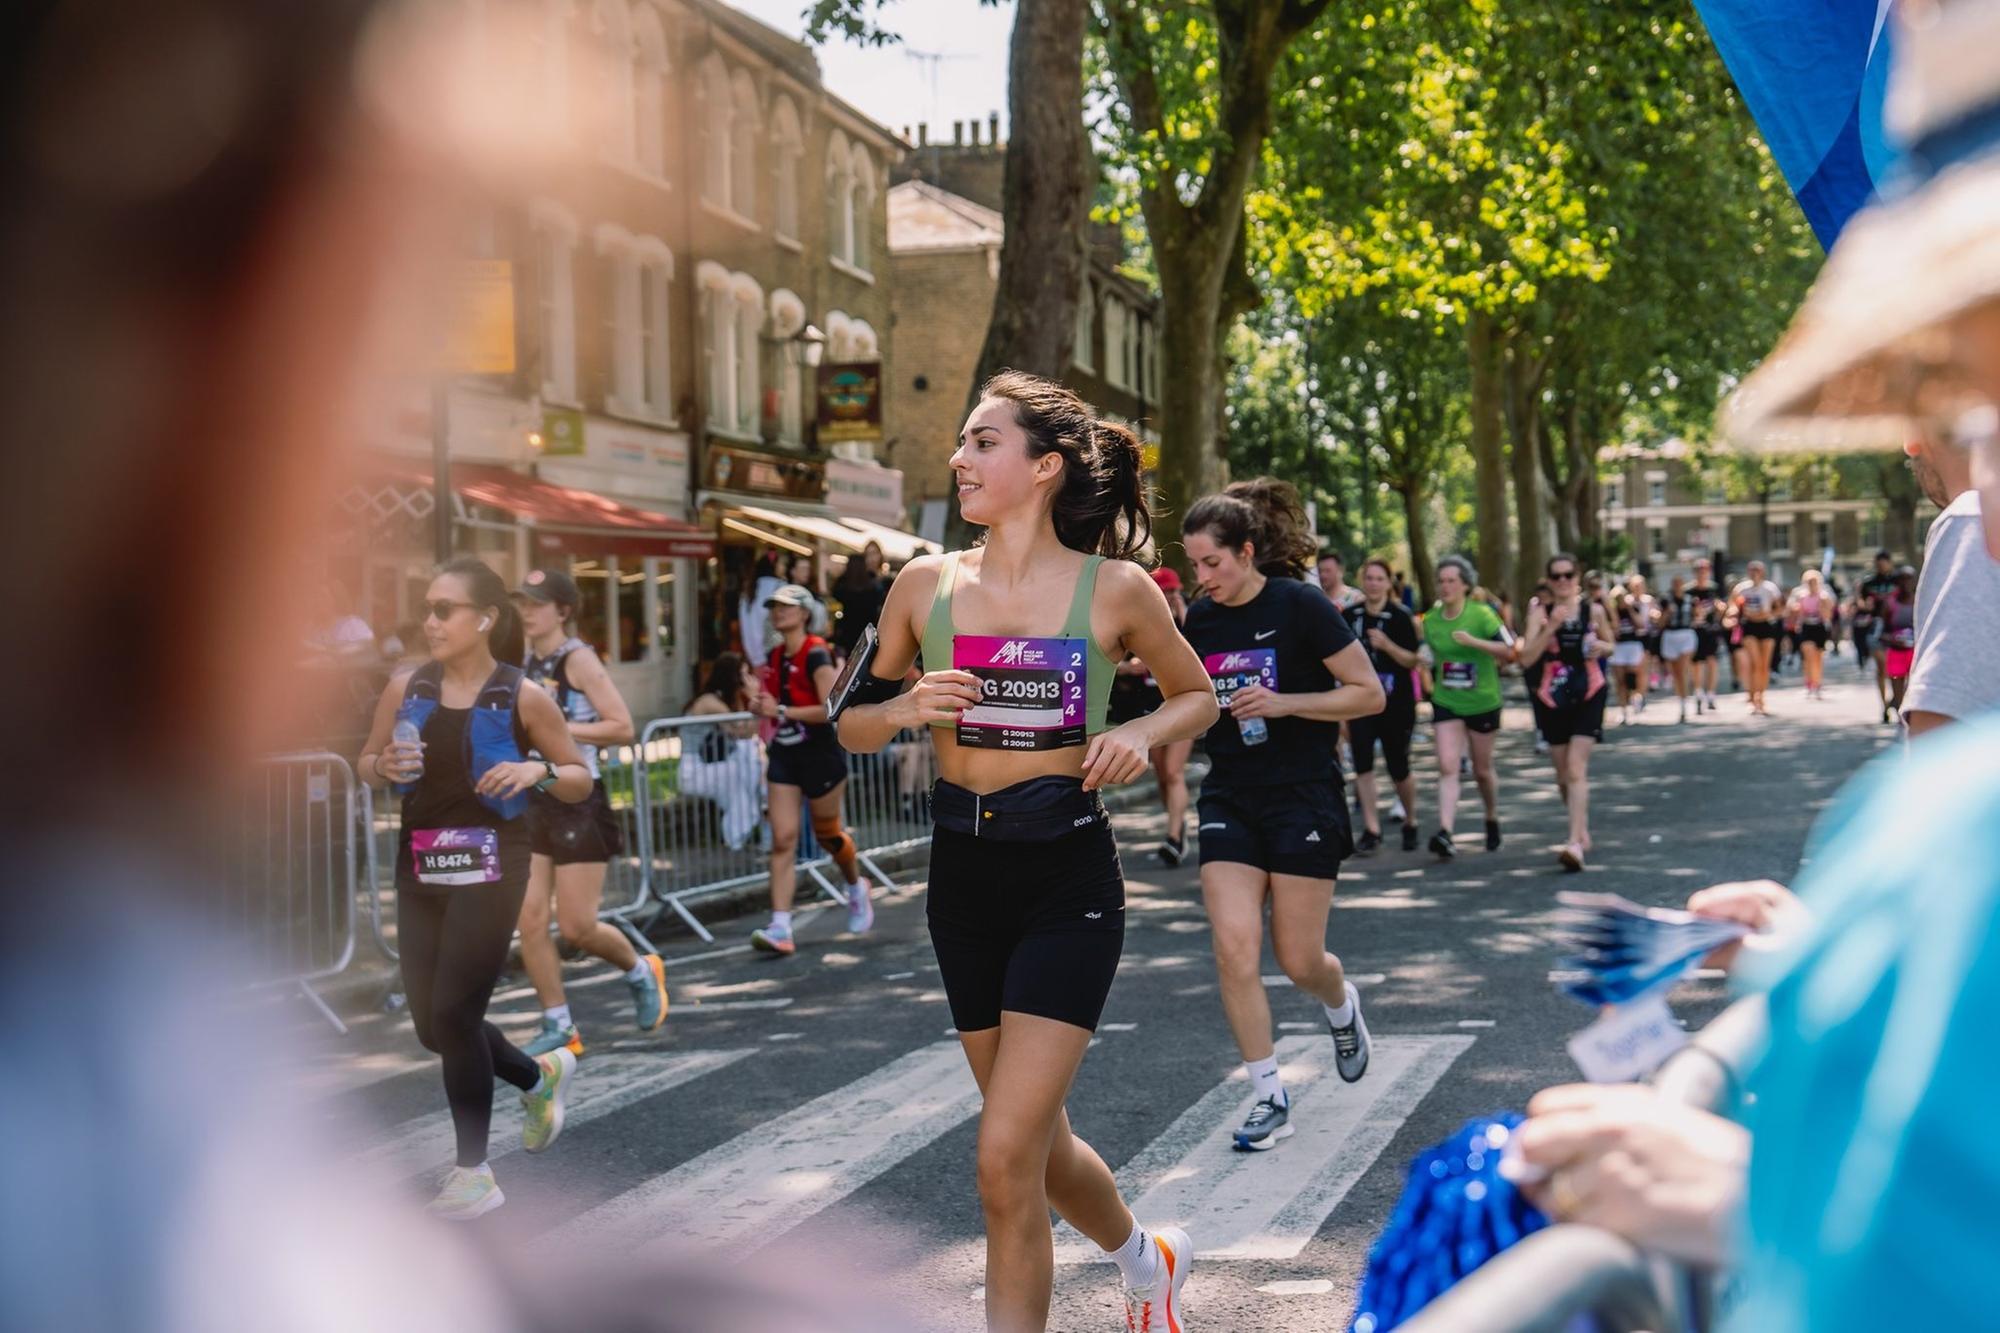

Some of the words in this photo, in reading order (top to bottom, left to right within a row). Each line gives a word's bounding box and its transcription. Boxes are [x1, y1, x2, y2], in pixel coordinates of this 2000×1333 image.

[983, 679, 998, 696] G
[1002, 681, 1060, 698] 20913
[425, 855, 436, 868] H
[437, 853, 473, 868] 8474
